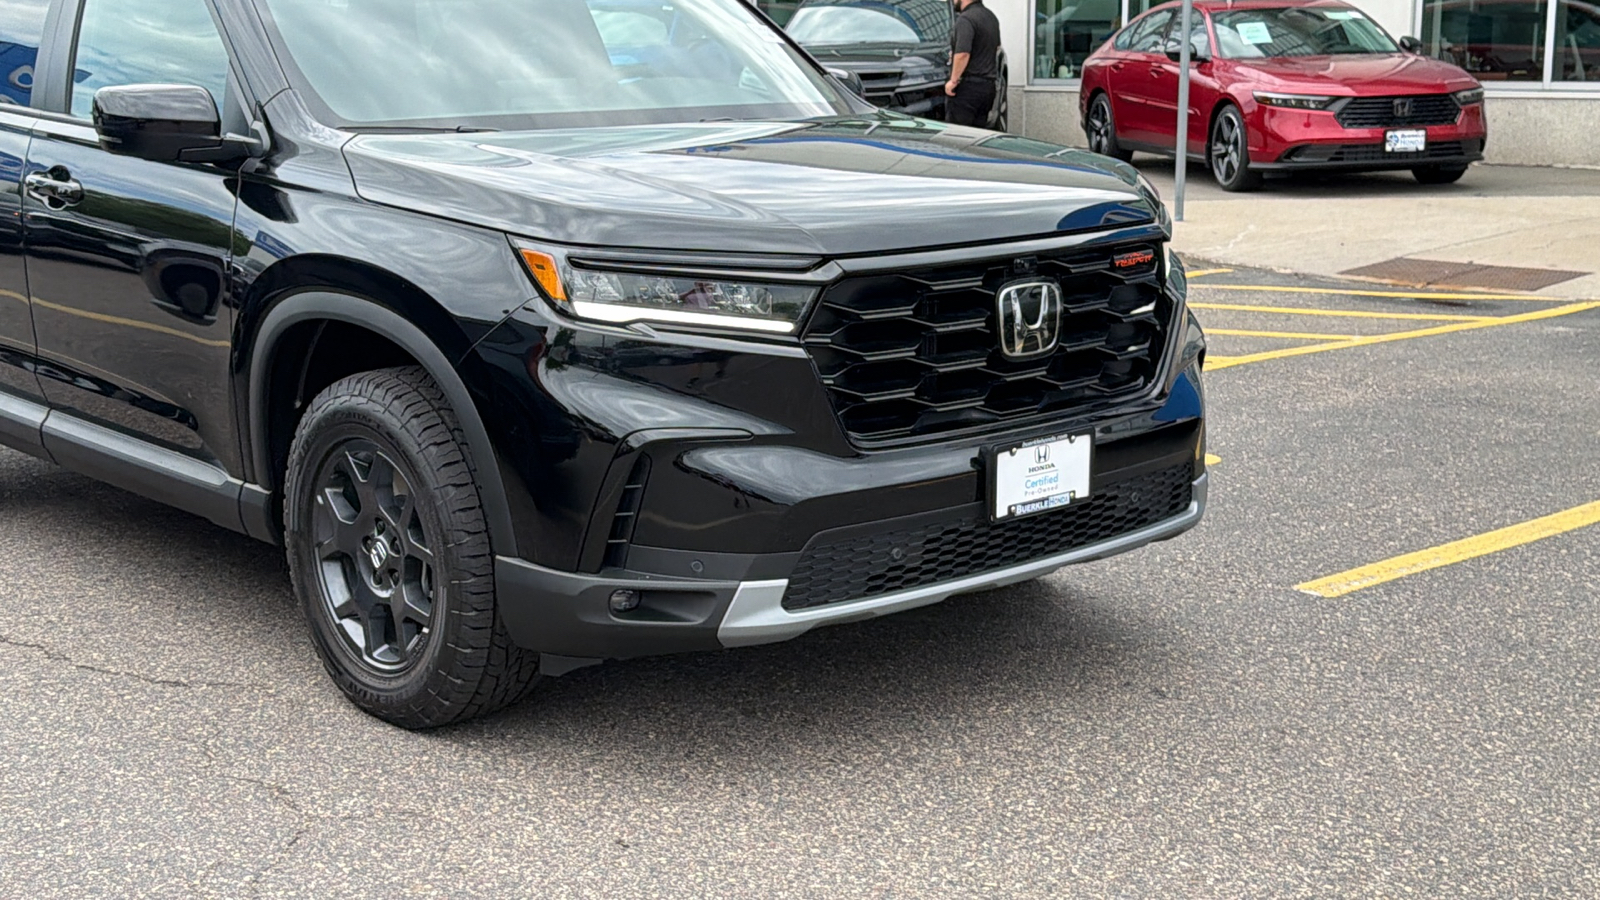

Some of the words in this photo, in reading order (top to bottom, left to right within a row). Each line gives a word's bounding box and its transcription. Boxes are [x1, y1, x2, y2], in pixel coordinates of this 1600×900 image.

[1028, 463, 1055, 473] HONDA
[1025, 473, 1058, 489] Certified
[1025, 485, 1058, 496] Pre-Owned
